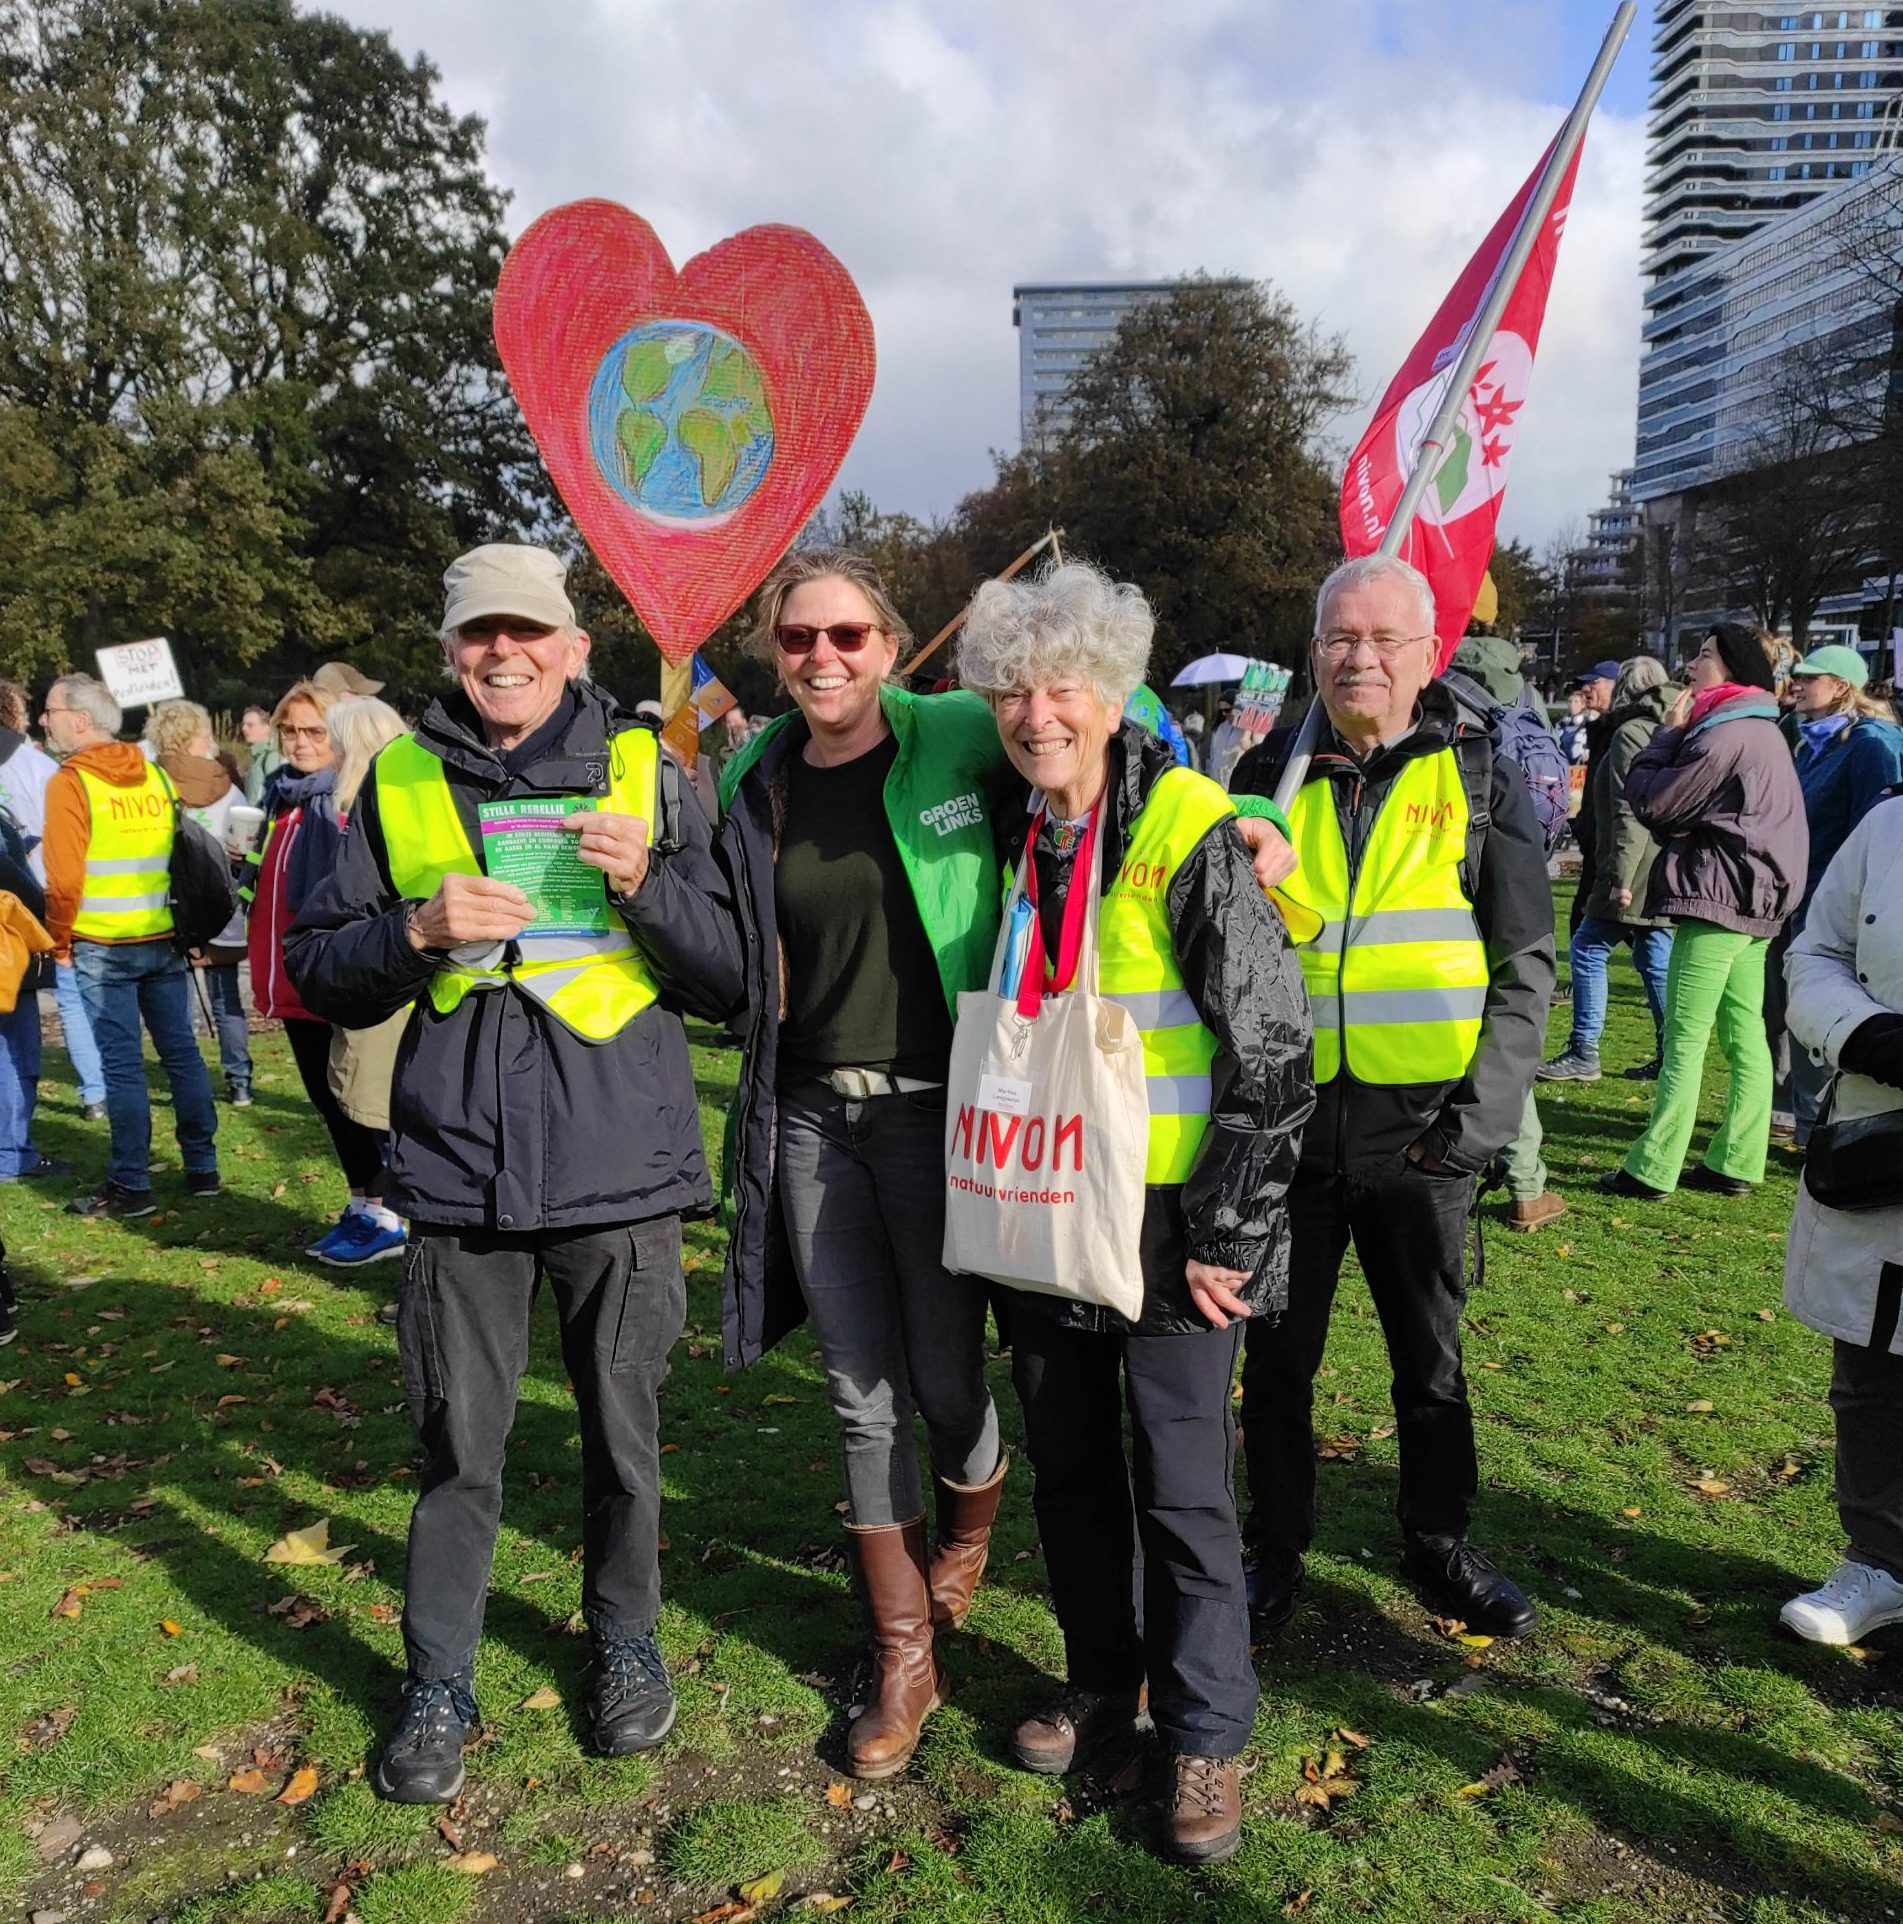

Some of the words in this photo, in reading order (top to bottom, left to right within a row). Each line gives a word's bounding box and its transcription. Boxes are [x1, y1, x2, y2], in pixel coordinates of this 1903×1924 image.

[1357, 453, 1386, 540] nivon.nl
[117, 643, 159, 664] STOP
[128, 663, 157, 675] MET
[483, 805, 516, 818] STILLE
[520, 803, 565, 815] REBELLIE
[920, 793, 979, 826] GROEN
[934, 808, 984, 837] LINKS
